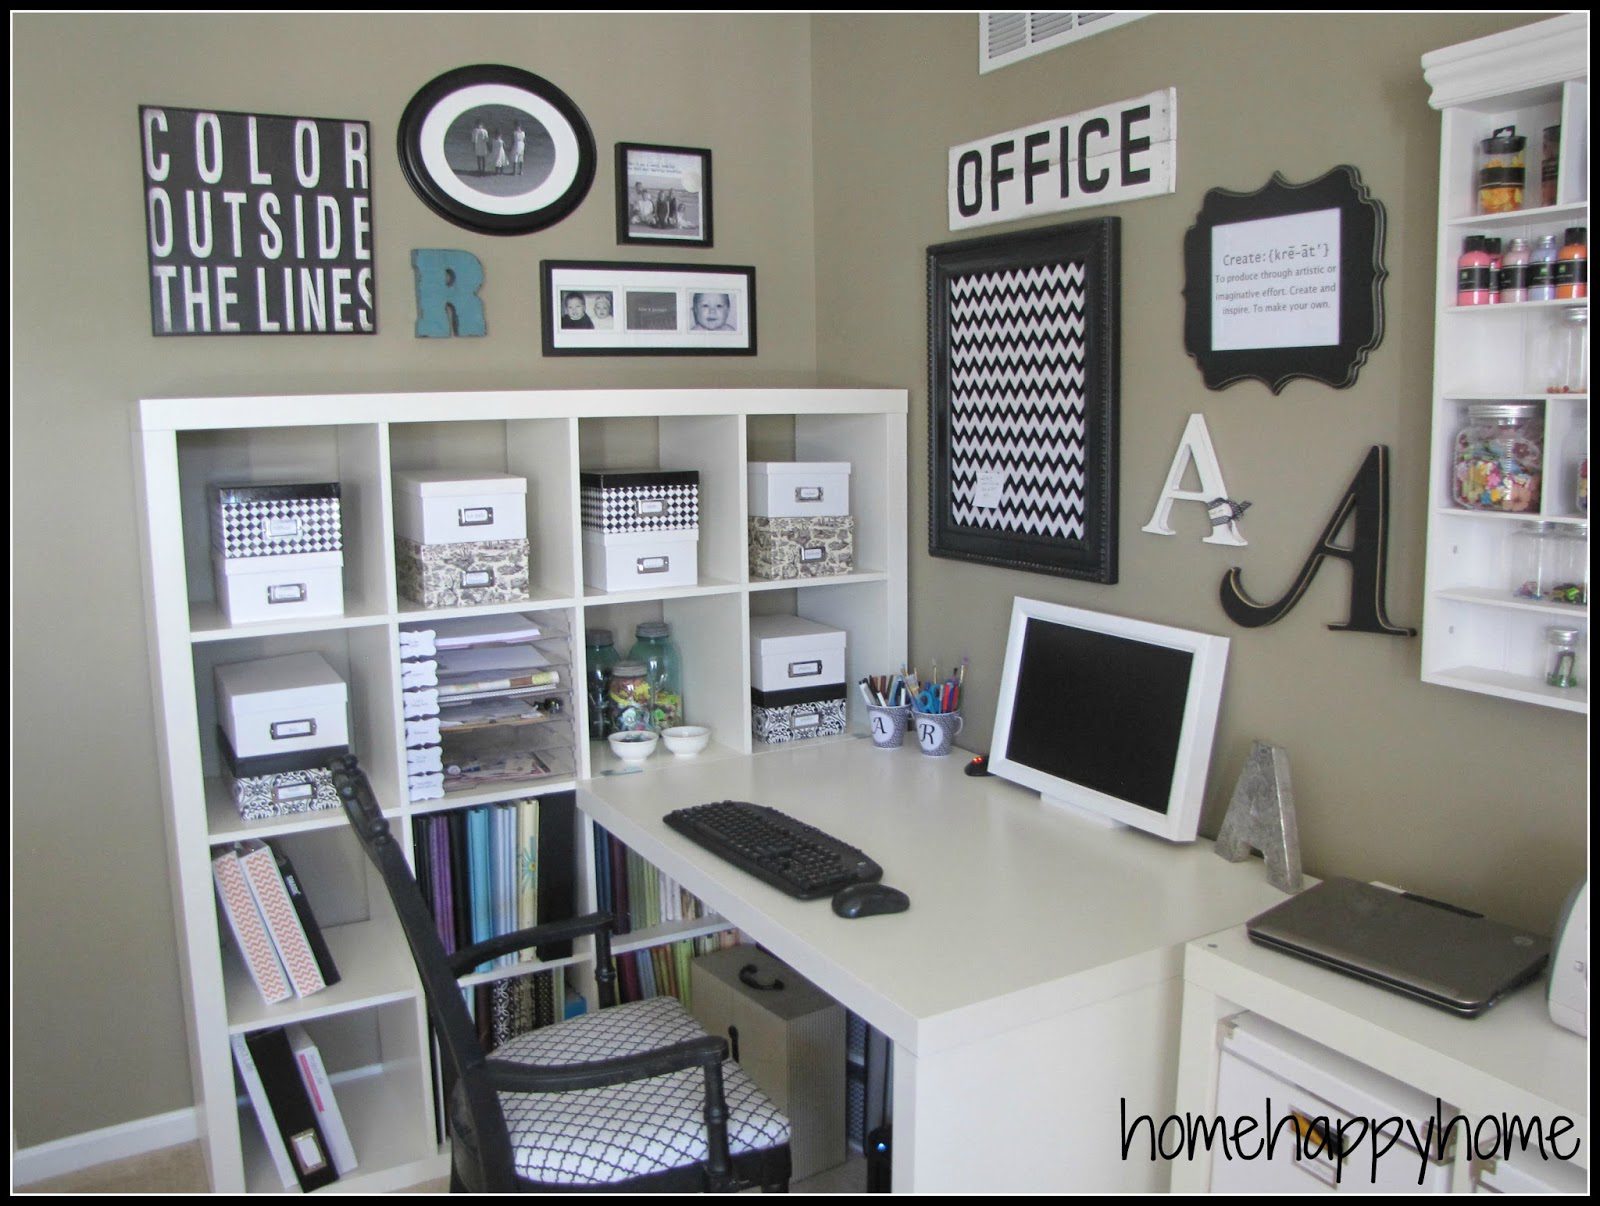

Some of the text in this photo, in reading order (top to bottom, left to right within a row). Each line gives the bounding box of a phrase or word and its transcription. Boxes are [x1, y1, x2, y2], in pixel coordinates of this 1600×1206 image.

[143, 108, 368, 189] COLOR
[957, 104, 1150, 217] OFFICE
[149, 187, 370, 260] OUTSIDE
[153, 265, 373, 332] THE LINES
[410, 248, 487, 338] R
[1215, 265, 1337, 284] To produce through artistic or
[1215, 283, 1336, 301] imaginative effort. Create and
[1222, 301, 1331, 316] inspire. To make your own.
[1141, 413, 1249, 546] A
[1220, 444, 1417, 636] A
[872, 716, 888, 735] A
[919, 723, 935, 745] R
